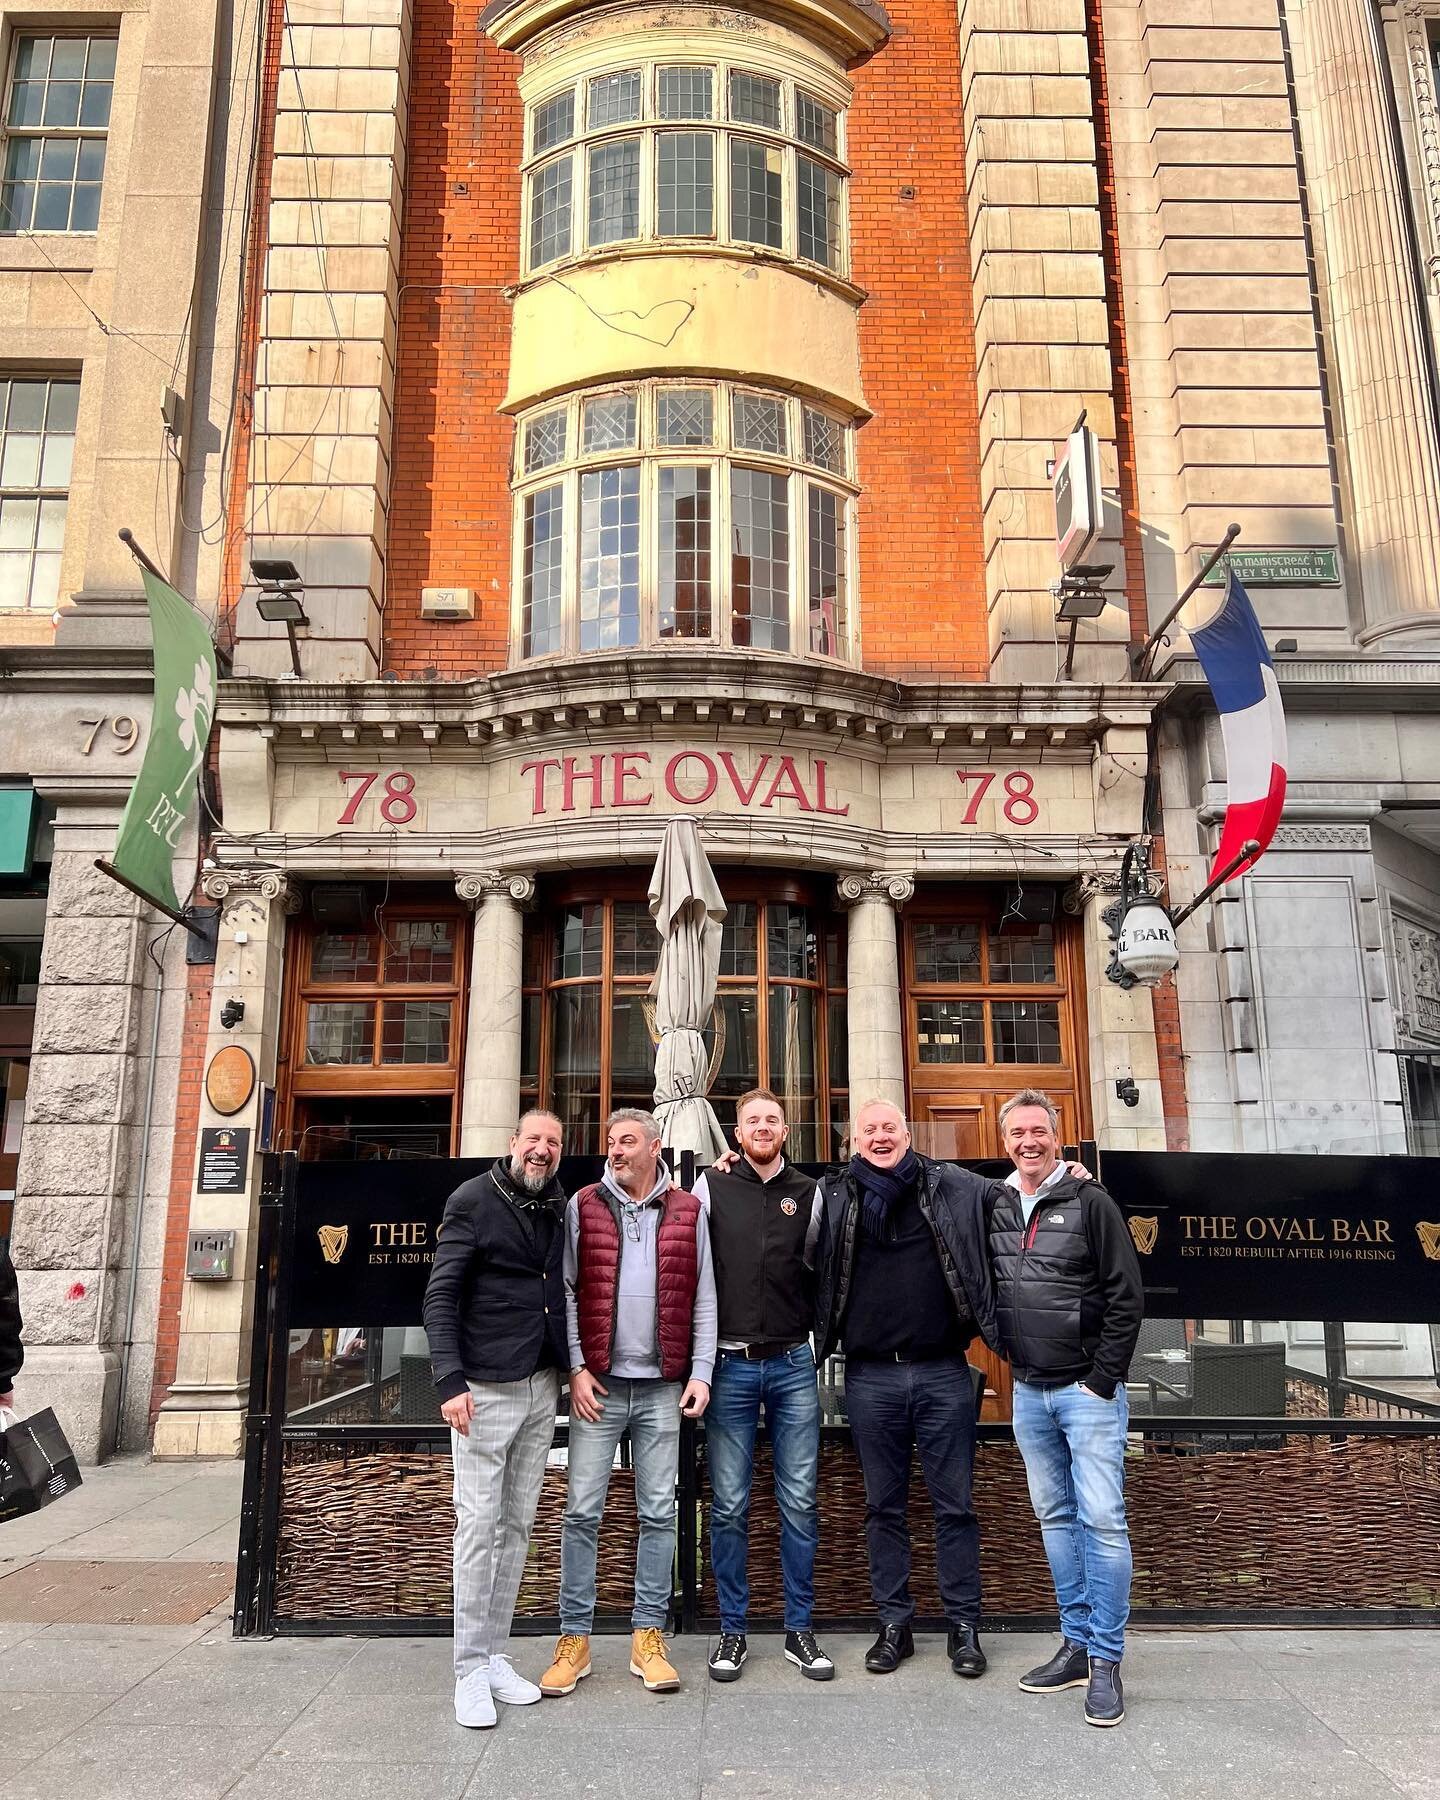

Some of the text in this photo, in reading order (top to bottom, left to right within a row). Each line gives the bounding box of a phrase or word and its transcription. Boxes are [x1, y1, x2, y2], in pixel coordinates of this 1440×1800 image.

[1219, 567, 1327, 578] ABEY ST. MIDDLE.
[77, 715, 140, 756] 79
[520, 751, 850, 816] THE OVAL
[337, 771, 417, 824] 78
[956, 770, 1039, 825] 78
[1133, 928, 1170, 943] BAR
[369, 1222, 428, 1246] THE
[1179, 1216, 1395, 1243] THE OVAL BAR
[369, 1253, 392, 1264] EST.
[396, 1253, 420, 1263] 1820
[1181, 1246, 1396, 1260] EST. 1820 REBUILT AFTER 1916 RISING
